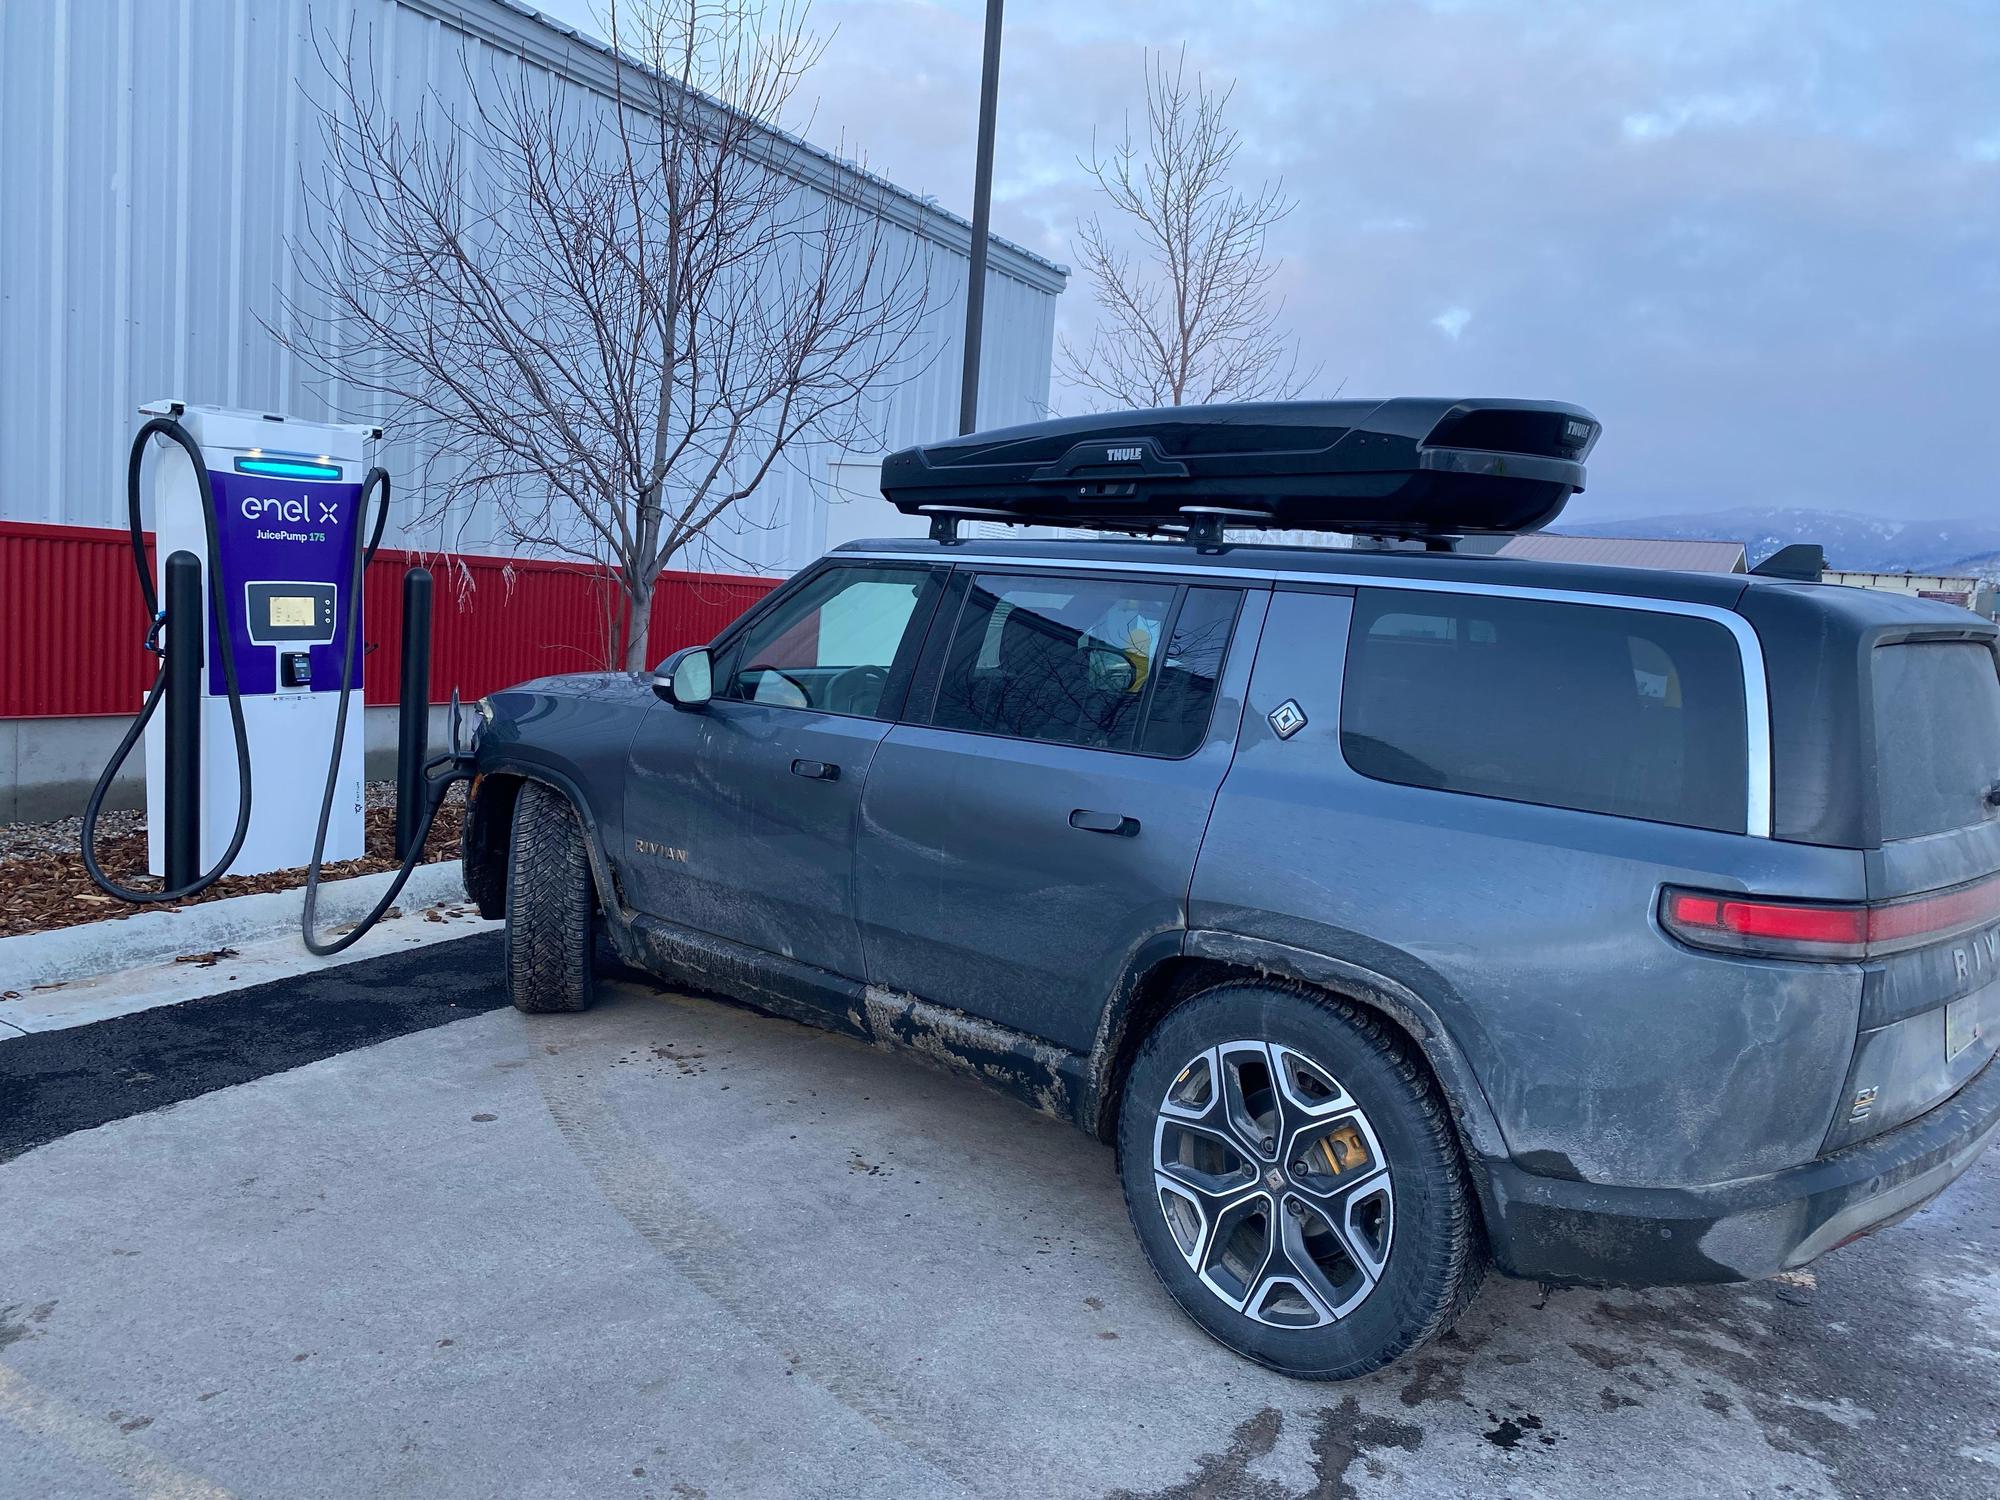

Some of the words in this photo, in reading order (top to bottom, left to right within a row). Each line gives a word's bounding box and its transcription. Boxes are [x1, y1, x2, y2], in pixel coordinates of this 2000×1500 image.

[1568, 421, 1590, 438] THULE
[1106, 447, 1142, 461] THULE
[241, 494, 311, 523] enel
[256, 529, 308, 543] JuicePump
[309, 532, 326, 542] 175
[635, 839, 689, 864] RIVIAN
